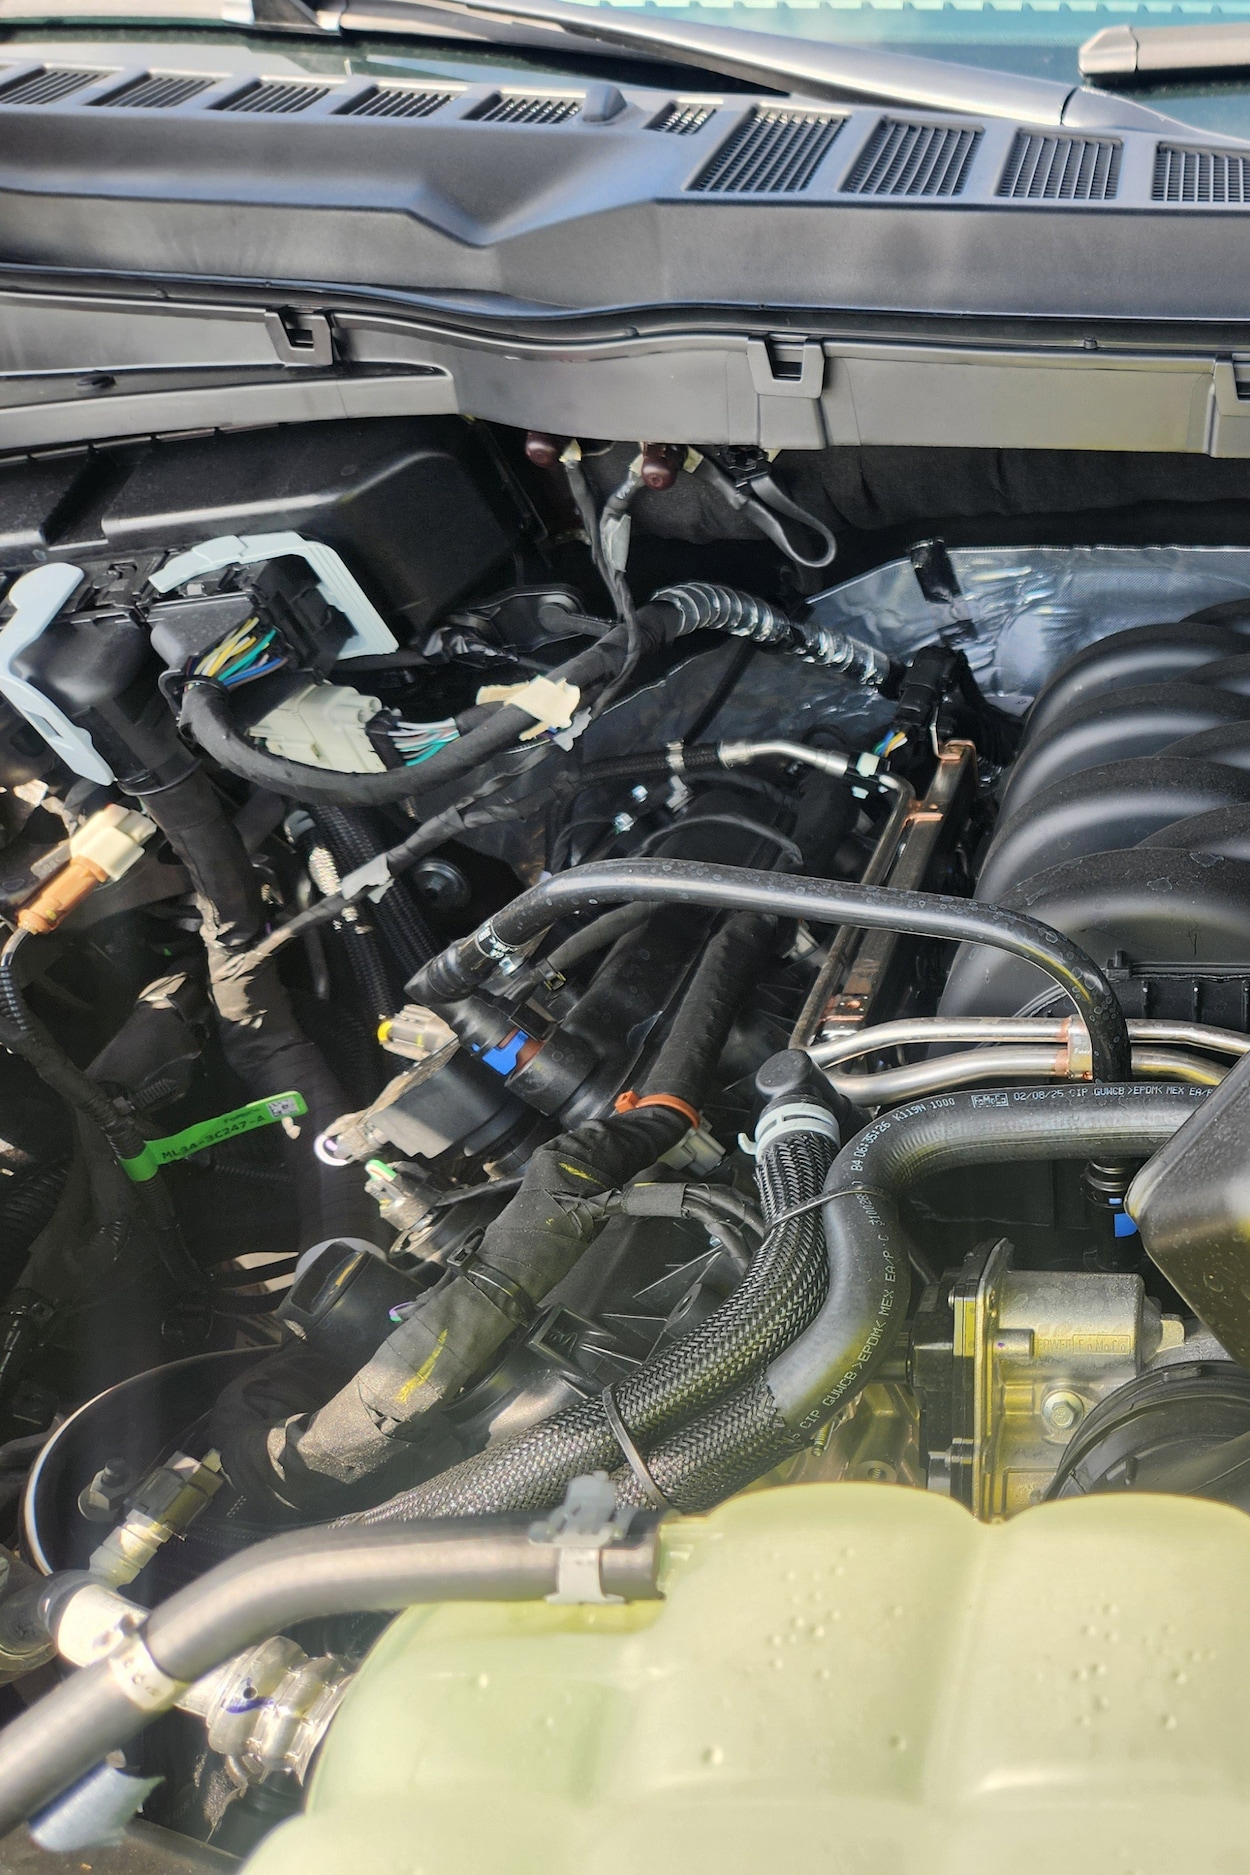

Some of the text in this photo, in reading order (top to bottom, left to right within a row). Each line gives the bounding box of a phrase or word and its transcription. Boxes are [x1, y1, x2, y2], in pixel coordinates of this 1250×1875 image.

[853, 1120, 891, 1158] 06:35:26
[930, 1097, 956, 1110] 1000
[1166, 1086, 1185, 1095] MEX
[799, 1409, 820, 1429] CIP
[878, 1289, 896, 1316] MEX
